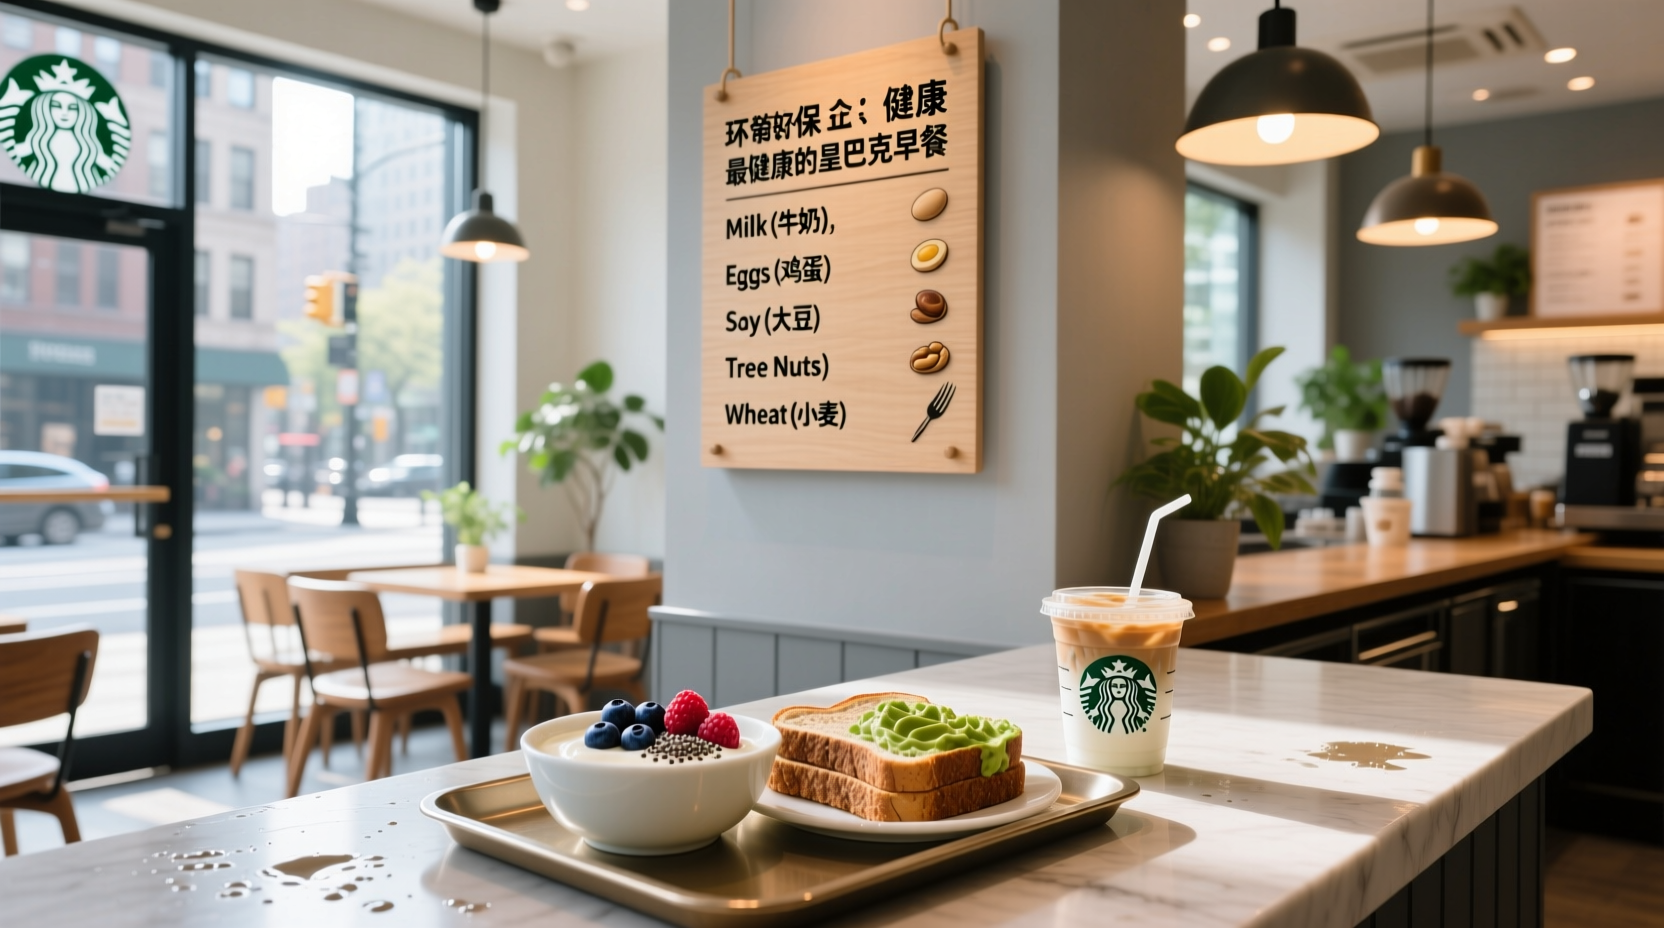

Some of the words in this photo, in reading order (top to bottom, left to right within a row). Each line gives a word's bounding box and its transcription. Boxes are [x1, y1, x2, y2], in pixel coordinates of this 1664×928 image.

[726, 212, 768, 240] Milk
[726, 264, 771, 292] Eggs
[774, 254, 831, 287] (鸡蛋)
[764, 304, 821, 336] (大豆)
[725, 357, 769, 379] Tree
[773, 352, 829, 382] Nuts)
[725, 402, 788, 426] Wheat
[790, 400, 847, 431] (小麦)
